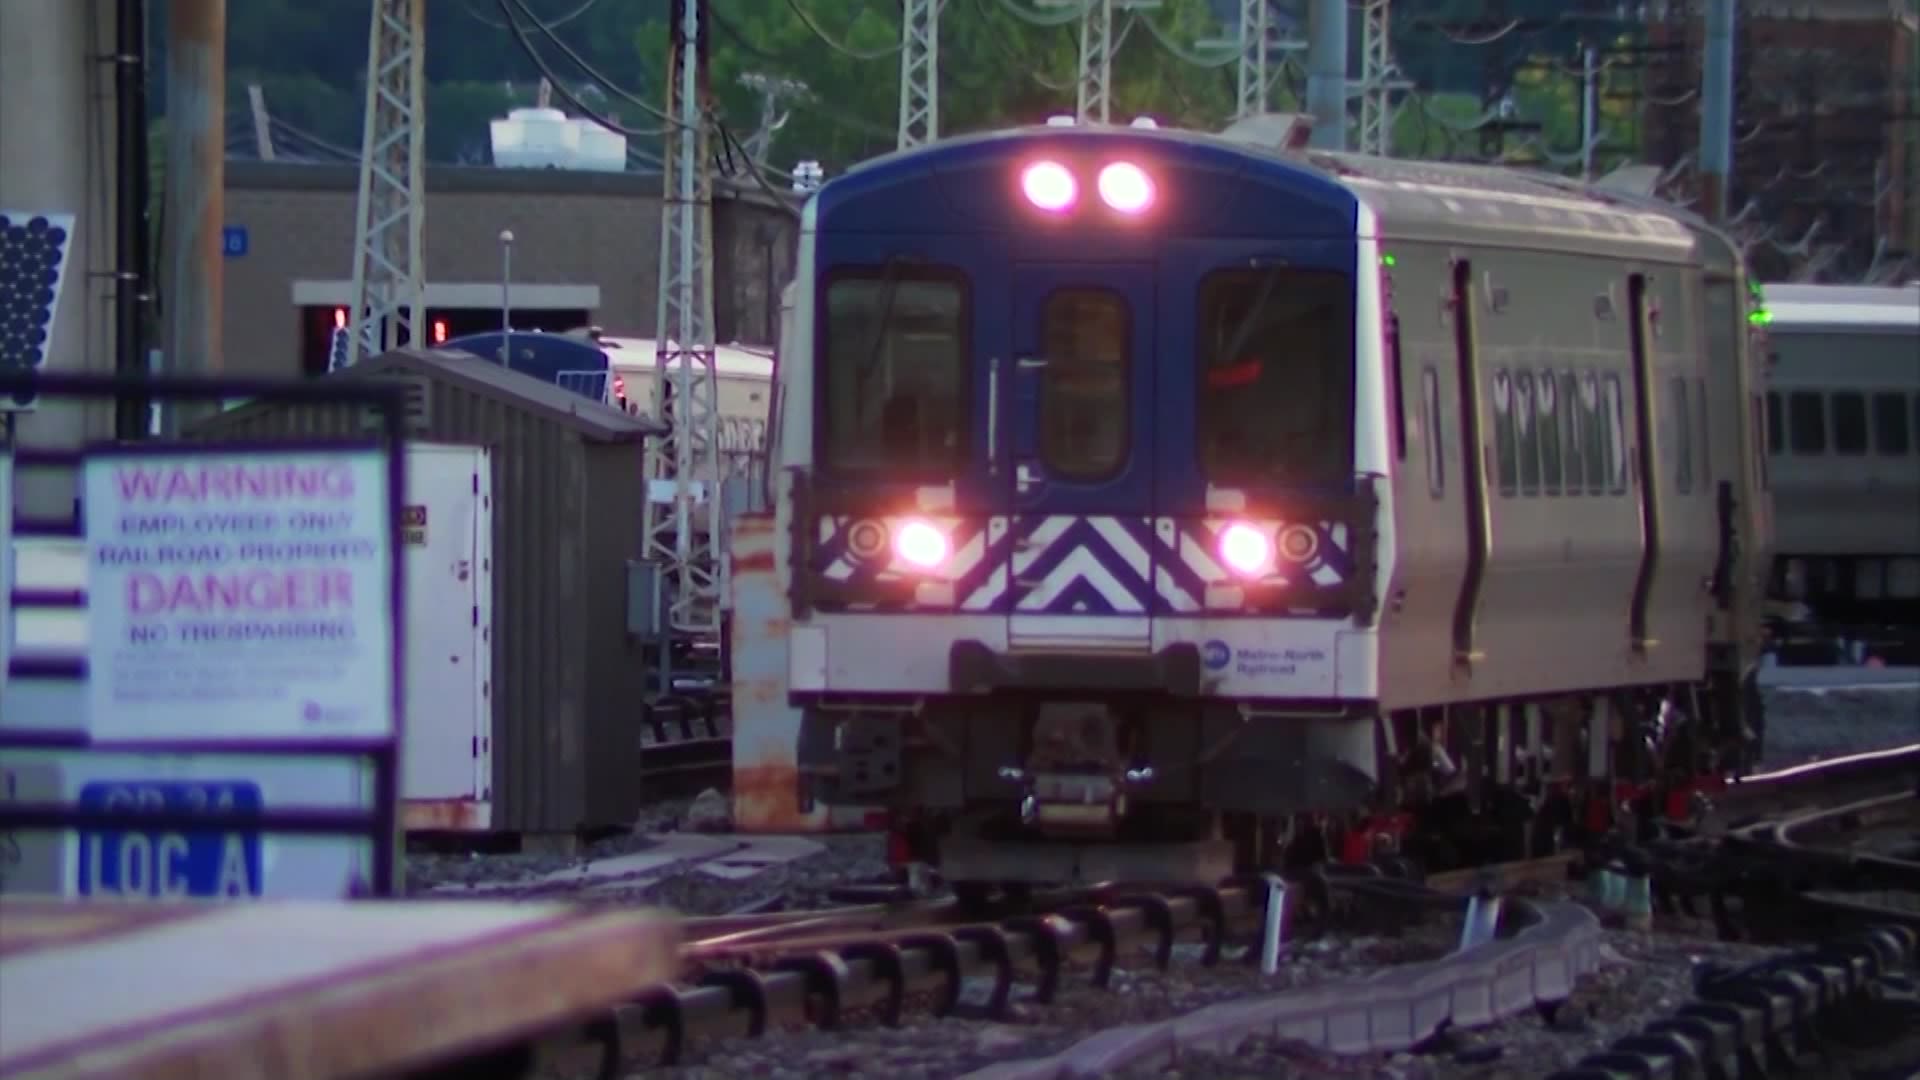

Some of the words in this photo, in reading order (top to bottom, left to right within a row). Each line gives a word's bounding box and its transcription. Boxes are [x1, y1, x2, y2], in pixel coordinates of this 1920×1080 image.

[116, 464, 356, 503] WARNING
[288, 510, 353, 530] ONLY
[98, 541, 230, 566] RAILROAD
[239, 540, 378, 561] PROPERTY
[126, 568, 354, 616] DANGER
[129, 623, 169, 645] NO
[180, 621, 356, 642] TRESPASSING
[1236, 649, 1325, 662] Metro-North
[217, 832, 253, 898] A
